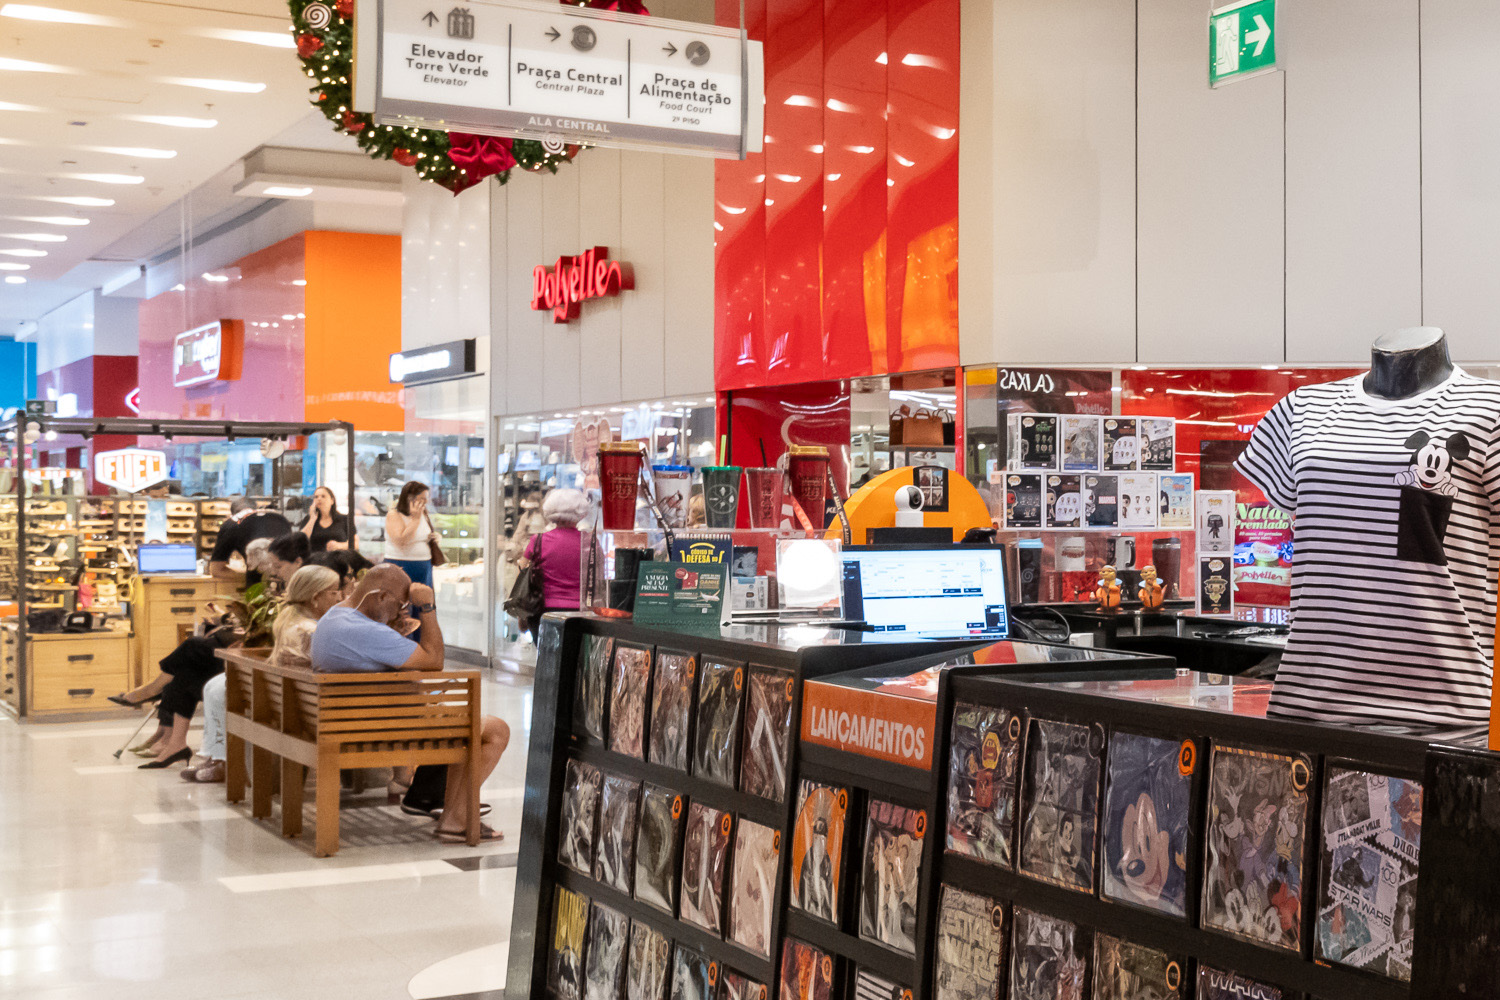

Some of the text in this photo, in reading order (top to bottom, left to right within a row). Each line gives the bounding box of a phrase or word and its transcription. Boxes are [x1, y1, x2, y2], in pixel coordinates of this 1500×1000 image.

[411, 43, 484, 64] Elevador
[406, 58, 489, 78] Torre Verde
[517, 62, 623, 87] Praça Central
[423, 73, 468, 88] Elevator
[535, 79, 605, 97] Central Plaza
[654, 73, 718, 93] Praça de
[639, 84, 732, 107] Alimentação
[659, 100, 713, 115] Food Court
[528, 117, 611, 133] ALA CENTRAL
[683, 116, 700, 125] PISO
[103, 453, 161, 484] FUEL
[686, 555, 711, 563] DEFESA
[1330, 884, 1392, 927] STAR WARS
